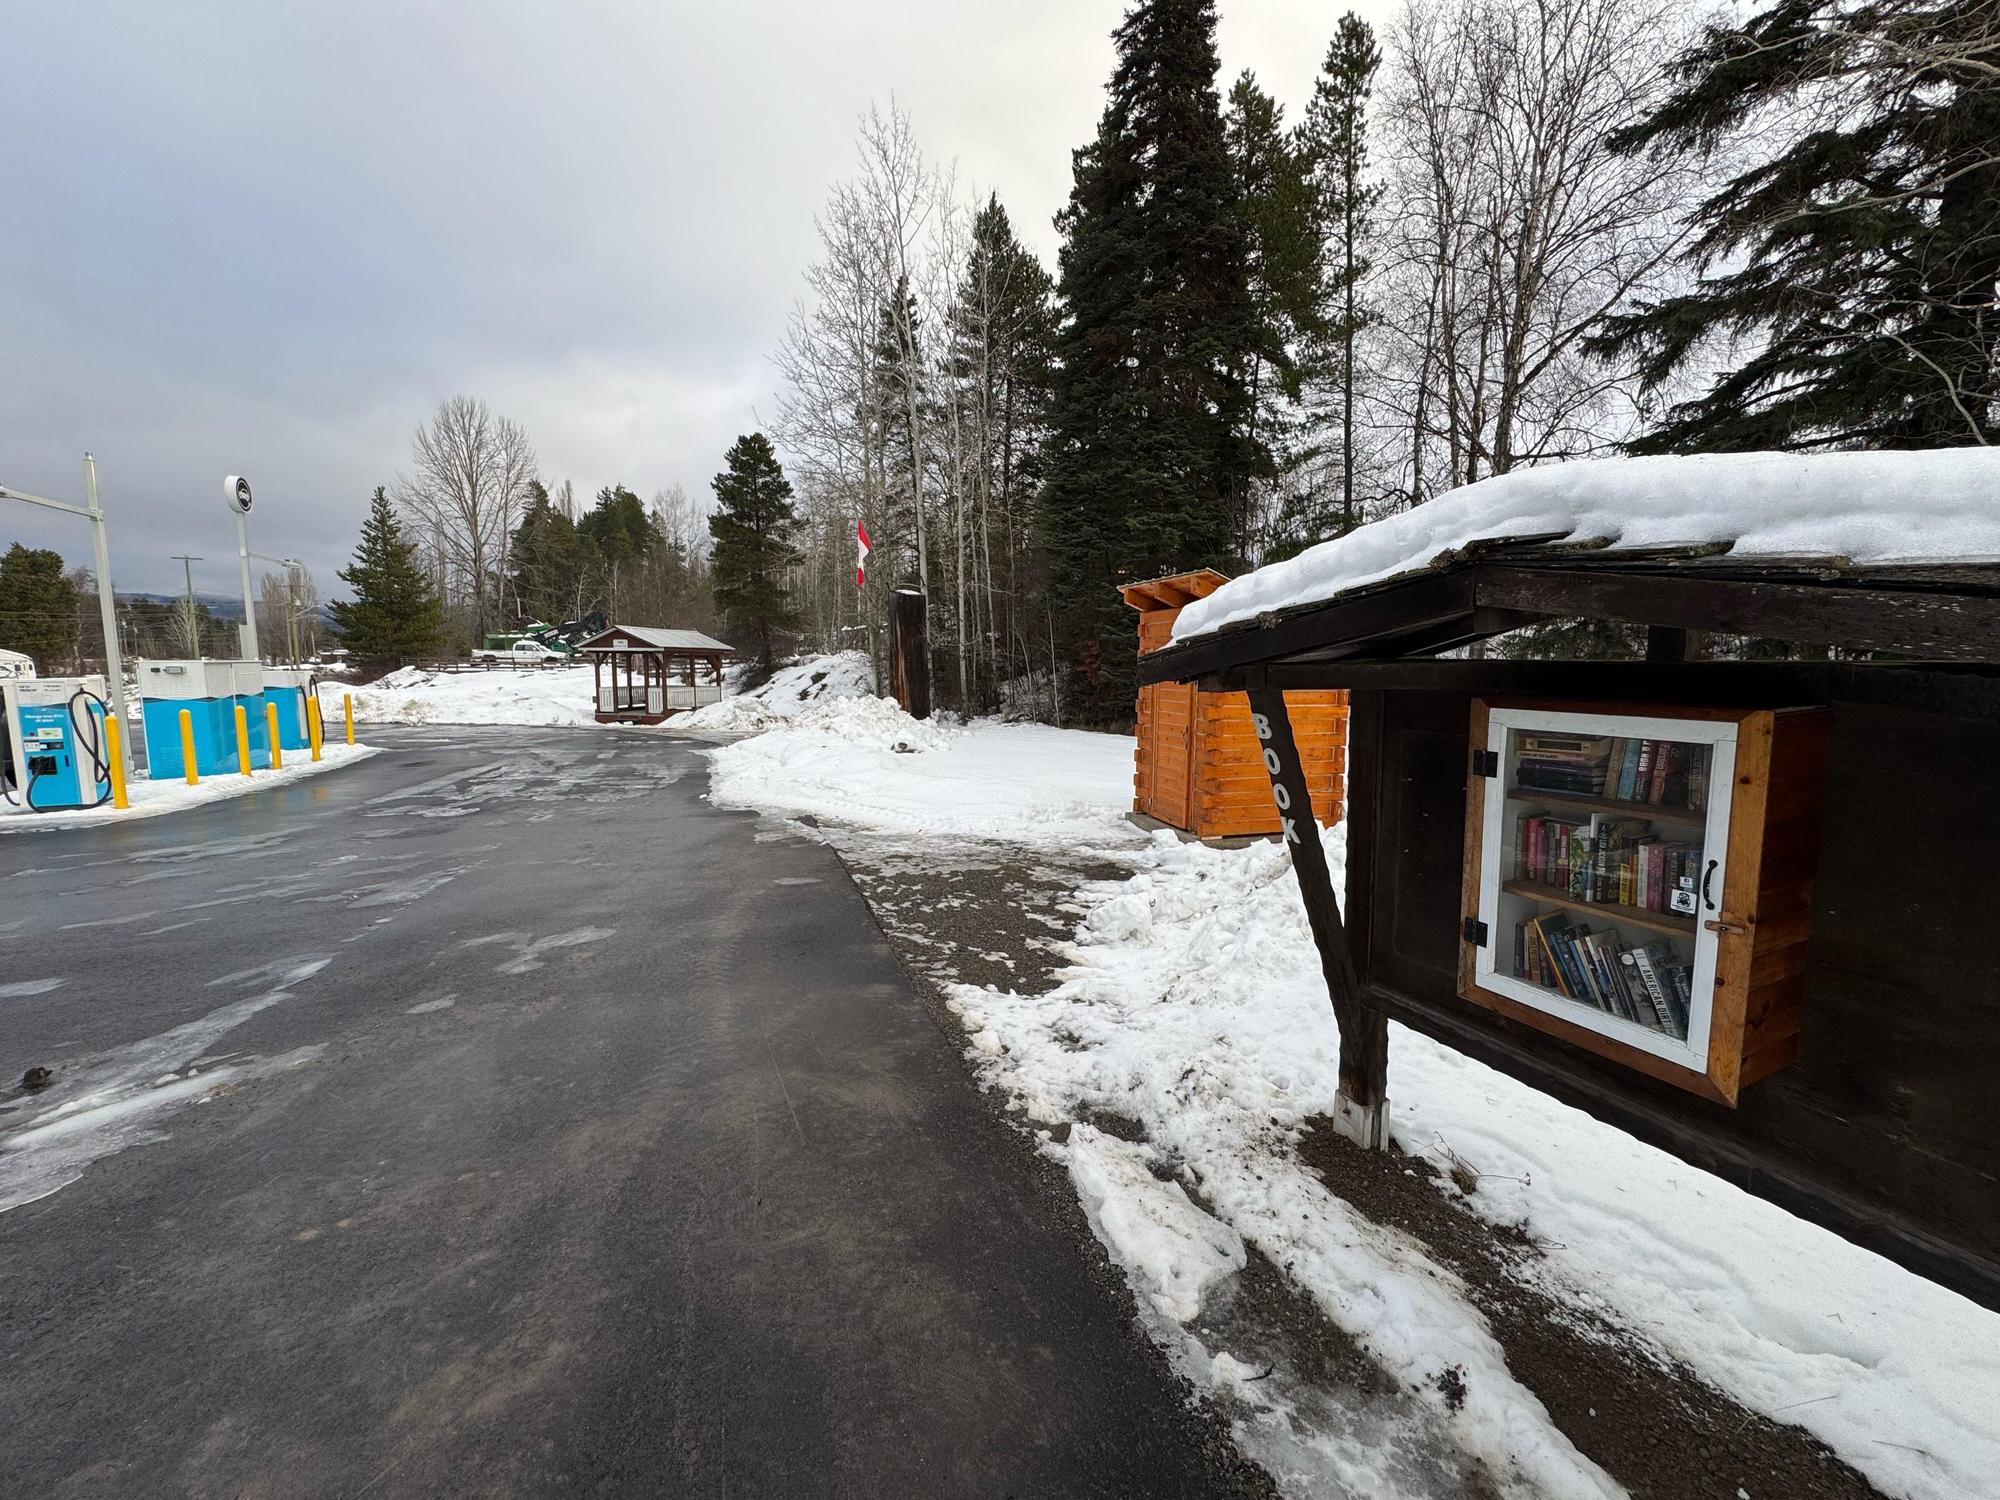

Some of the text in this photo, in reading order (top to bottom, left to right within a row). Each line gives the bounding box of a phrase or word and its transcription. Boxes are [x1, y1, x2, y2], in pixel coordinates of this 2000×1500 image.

[1252, 713, 1301, 845] BOOK
[1638, 753, 1650, 772] ROBB
[1642, 969, 1671, 1024] AMERICAN DIRT
